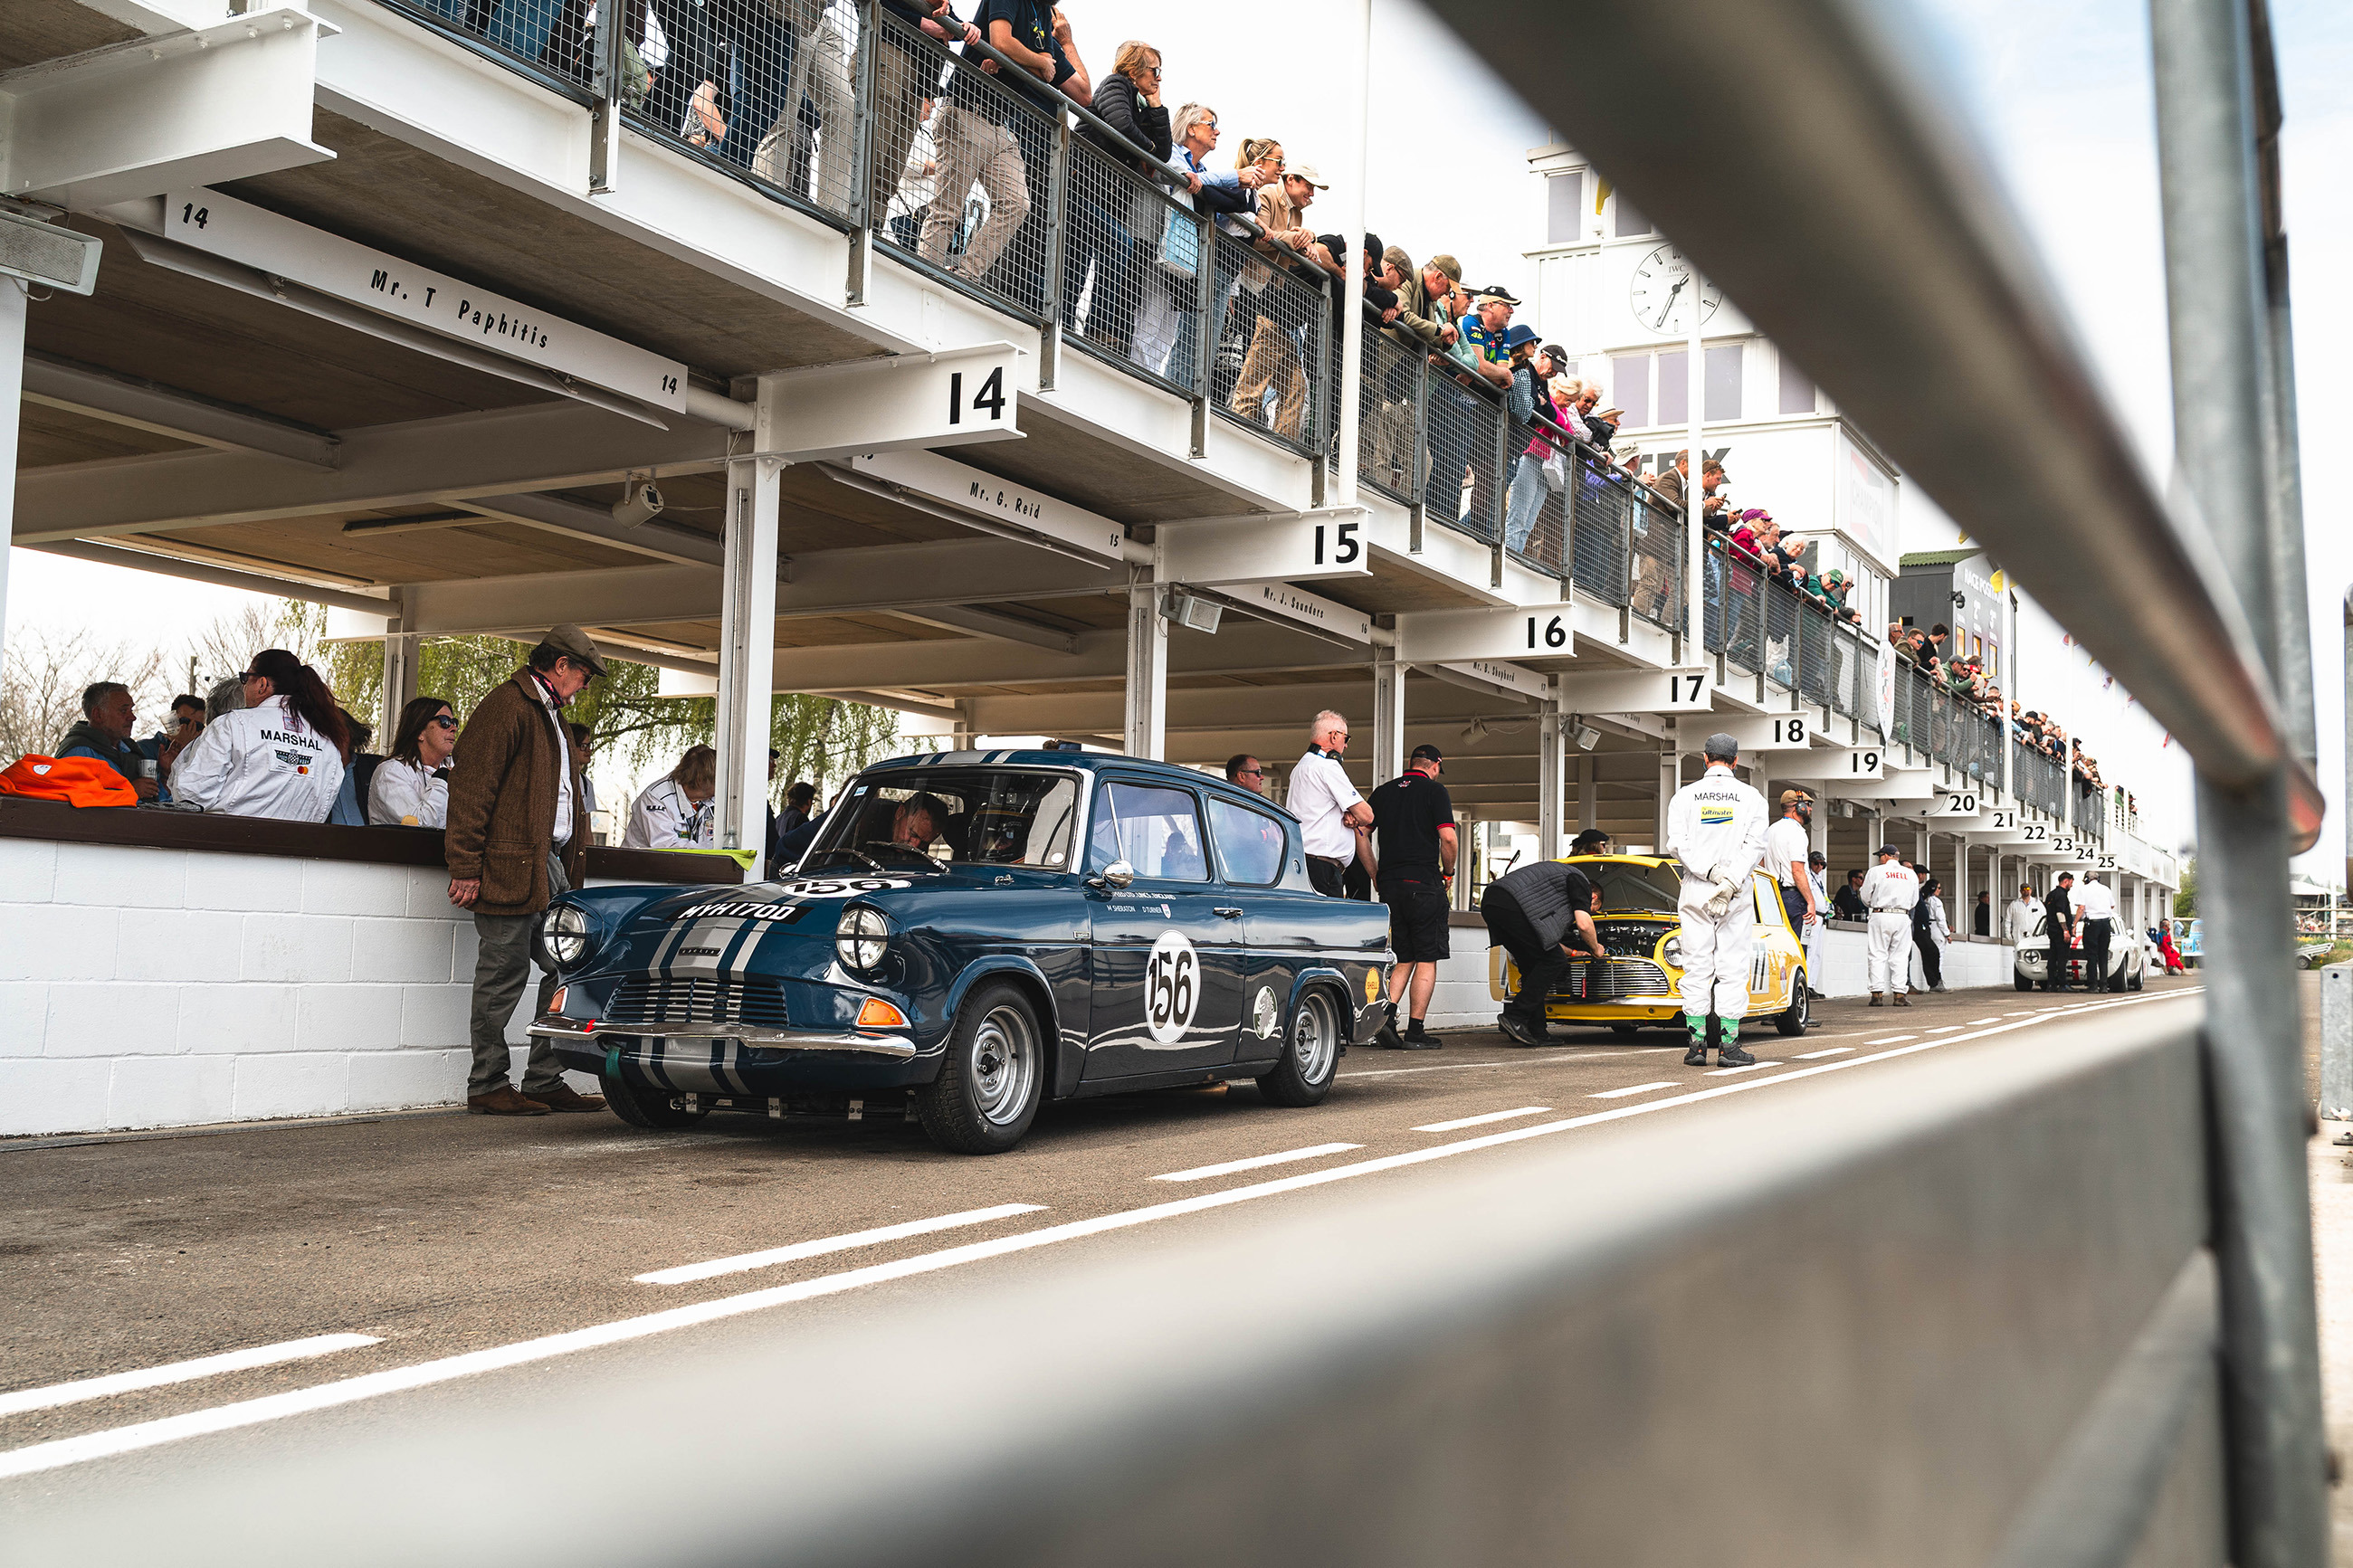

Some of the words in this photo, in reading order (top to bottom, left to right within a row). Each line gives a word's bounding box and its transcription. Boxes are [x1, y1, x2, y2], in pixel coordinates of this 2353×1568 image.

[182, 202, 209, 230] 14
[1669, 264, 1686, 273] IWC
[370, 269, 408, 300] Mr.
[424, 287, 437, 309] T
[458, 299, 548, 349] Paphitis
[662, 374, 678, 395] 14
[950, 366, 1005, 425] 14
[970, 481, 989, 502] Mr.
[996, 490, 1007, 508] G.
[1015, 497, 1041, 519] Reid
[1110, 533, 1119, 547] 15
[1314, 522, 1359, 565] 15
[1263, 587, 1276, 601] Mr.
[1280, 592, 1287, 605] J.
[1291, 596, 1324, 619] Saunders
[1361, 622, 1367, 634] 16
[1528, 615, 1566, 649] 16
[1672, 675, 1705, 703] 17
[261, 729, 323, 752] MARSHAL
[1775, 719, 1804, 743] 18
[1853, 752, 1878, 773] 19
[1694, 792, 1740, 803] MARSHAL
[1949, 794, 1975, 812] 20
[1993, 813, 2013, 828] 21
[2024, 826, 2045, 840] 22
[2053, 838, 2073, 851] 23
[2075, 848, 2094, 860] 24
[2098, 856, 2115, 868] 25
[1885, 871, 1908, 880] SHELL
[792, 879, 892, 894] 156
[1148, 950, 1192, 1030] 156
